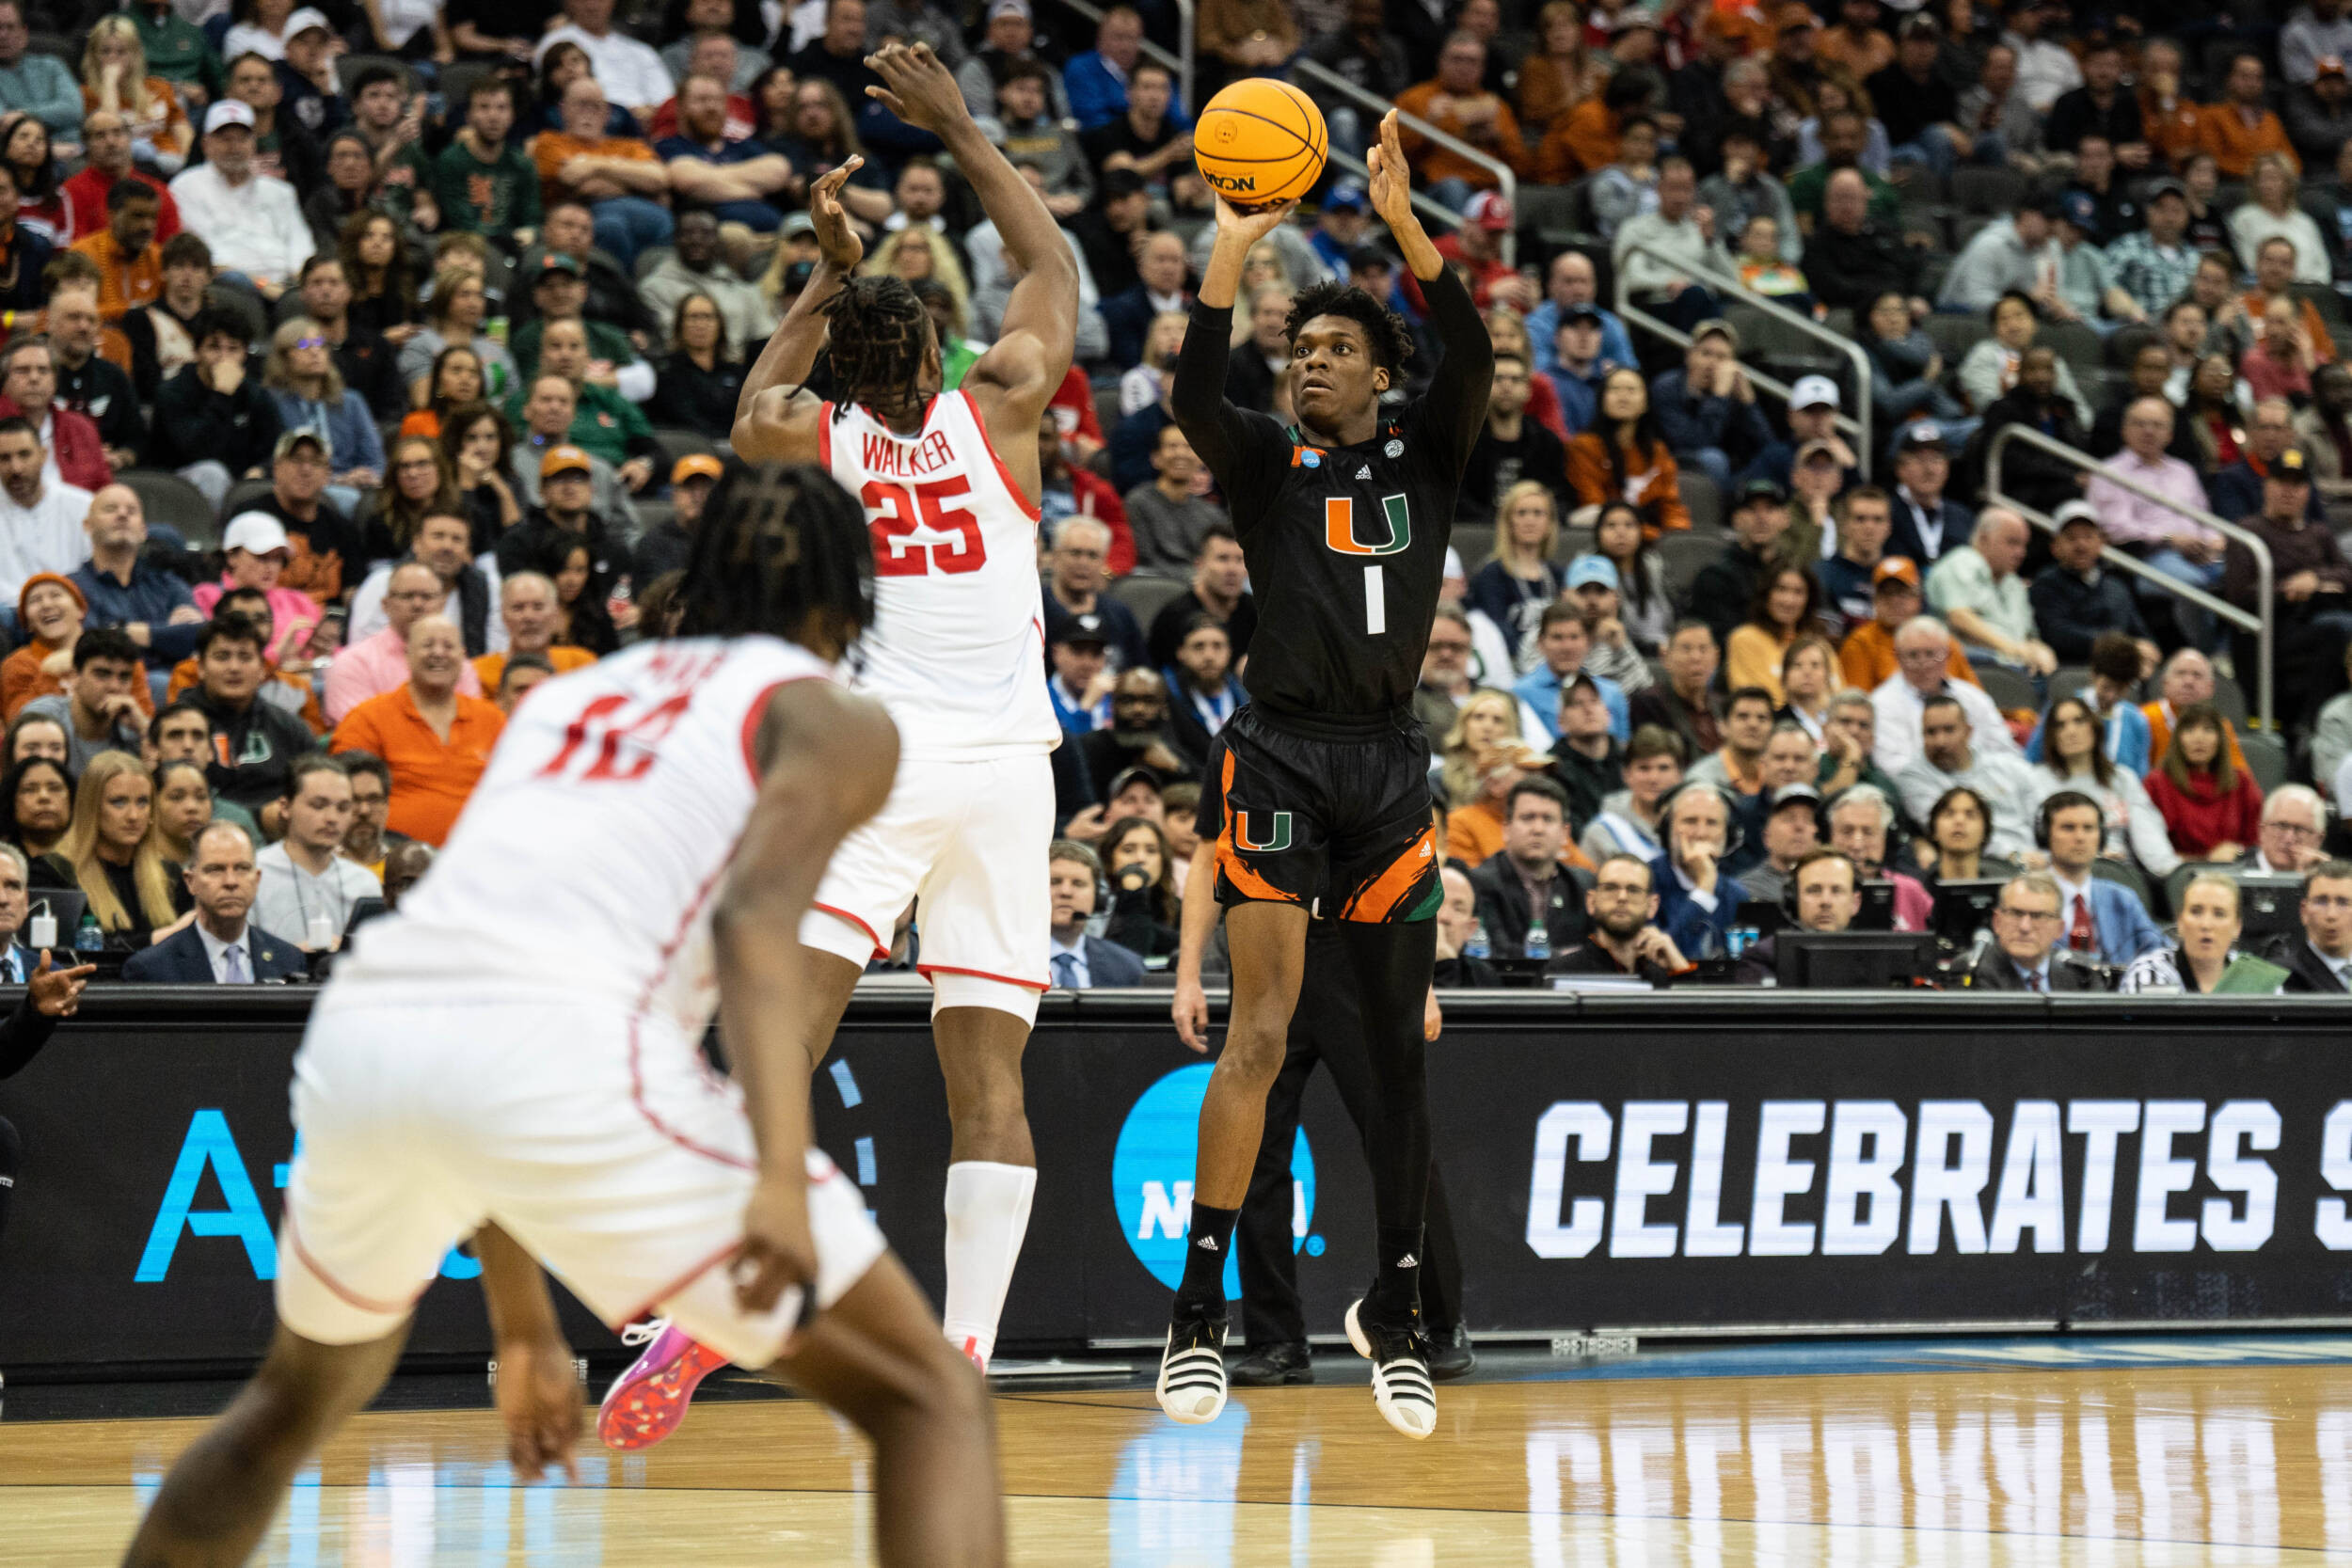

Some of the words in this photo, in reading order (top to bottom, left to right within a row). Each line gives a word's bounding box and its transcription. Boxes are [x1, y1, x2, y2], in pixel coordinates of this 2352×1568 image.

[863, 430, 956, 477] WALKER
[861, 473, 987, 577] 25
[1326, 492, 1411, 556] U
[1363, 564, 1386, 635] 1
[1235, 811, 1293, 852] U
[1525, 1100, 2283, 1259] CELEBRATES
